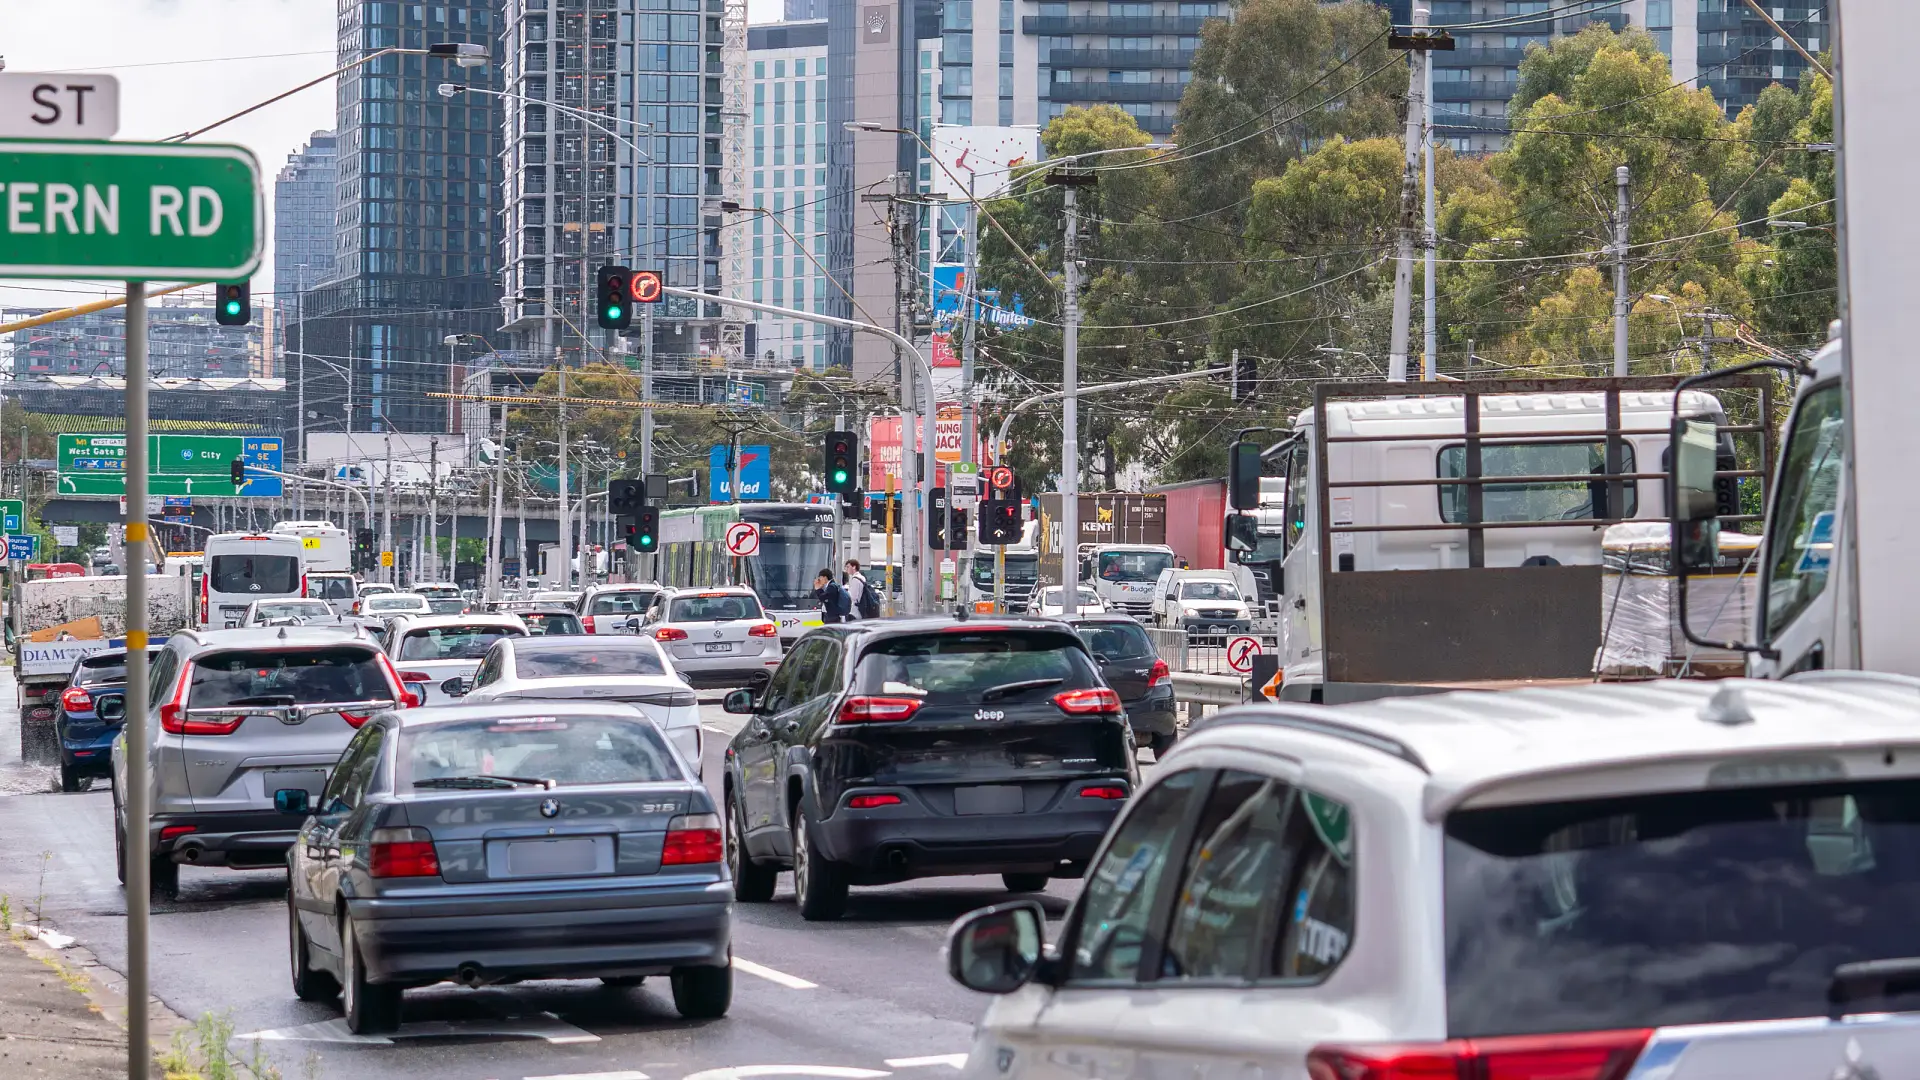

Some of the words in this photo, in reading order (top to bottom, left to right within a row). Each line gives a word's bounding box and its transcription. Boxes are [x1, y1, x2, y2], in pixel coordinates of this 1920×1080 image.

[30, 84, 95, 125] ST
[0, 182, 119, 235] ERN
[150, 185, 224, 236] RD
[936, 424, 962, 434] HUNG
[247, 443, 259, 451] M1
[936, 436, 962, 449] JACK
[68, 447, 91, 455] West
[93, 447, 115, 455] Gate
[183, 448, 192, 458] 60
[200, 451, 222, 460] City
[257, 452, 270, 461] SE
[104, 460, 118, 468] M2
[720, 481, 760, 494] Uted
[815, 514, 833, 522] 6100
[1082, 521, 1113, 532] KENT
[1130, 585, 1154, 594] Budget
[974, 709, 1005, 721] Jeep
